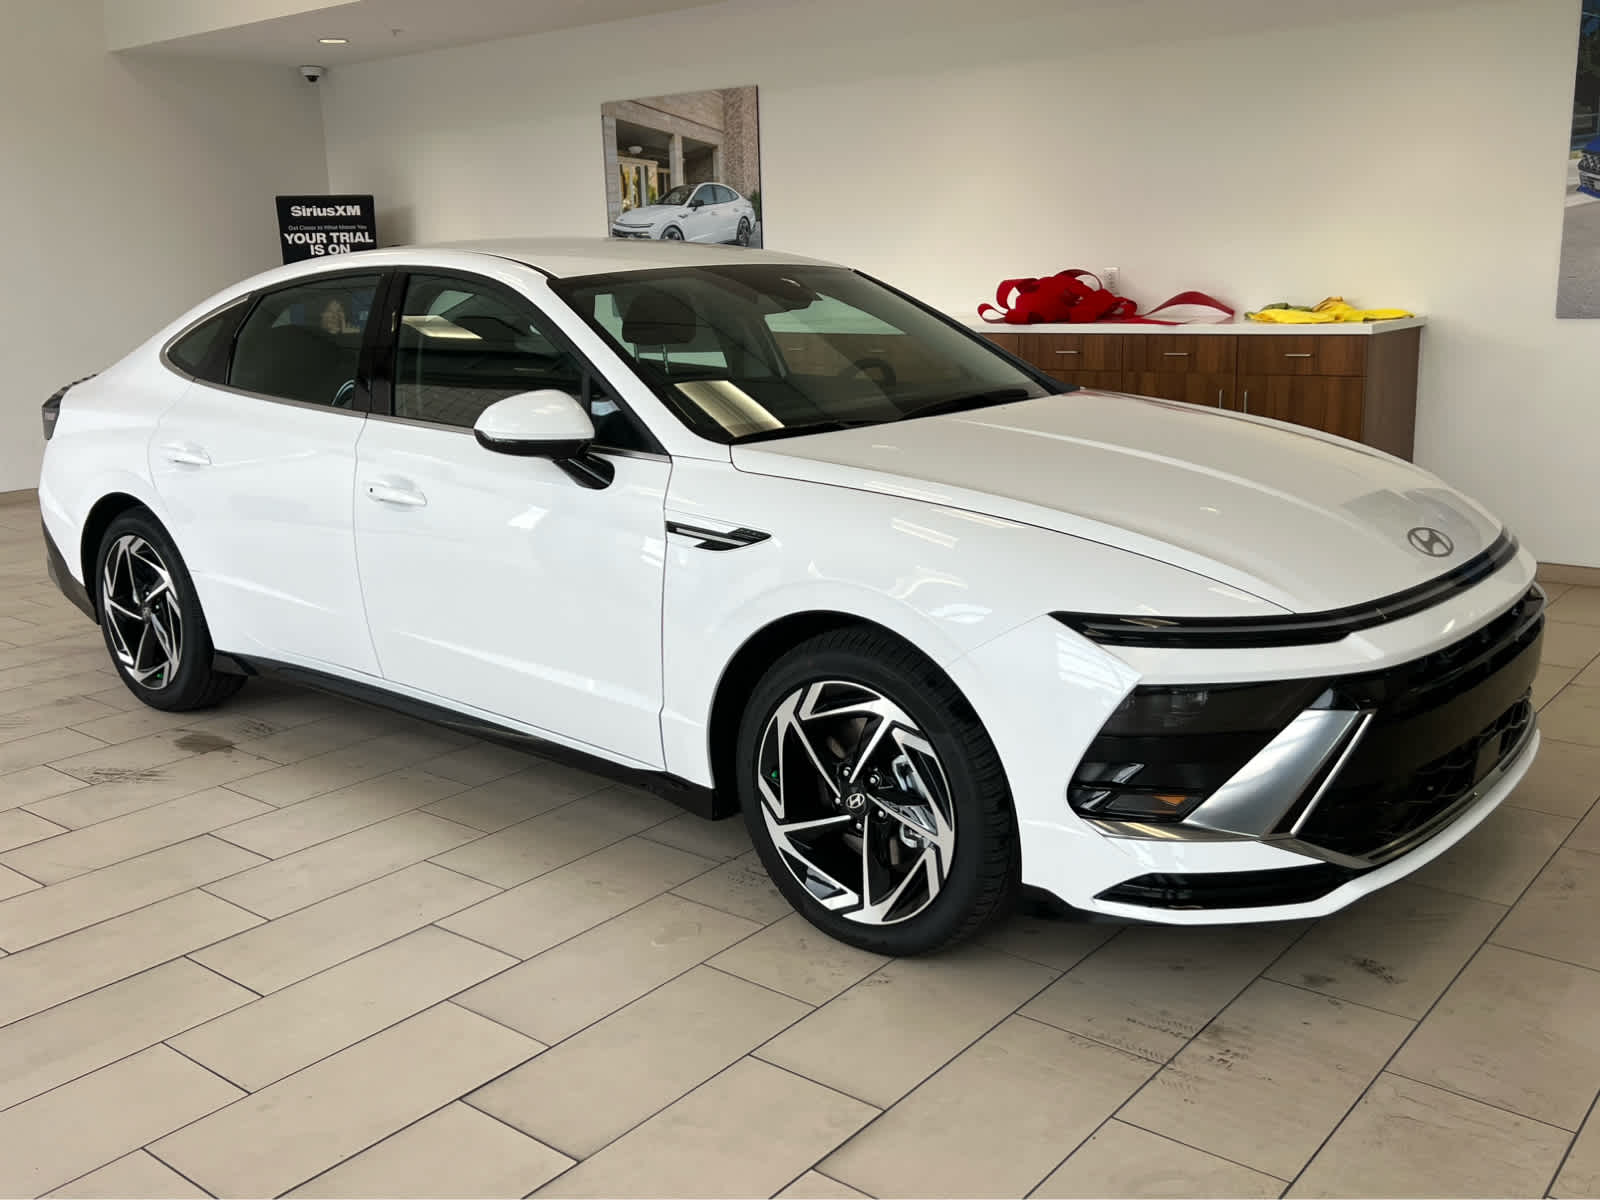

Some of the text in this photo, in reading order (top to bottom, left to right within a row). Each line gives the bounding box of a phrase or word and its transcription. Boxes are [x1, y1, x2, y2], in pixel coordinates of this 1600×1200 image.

[290, 205, 361, 217] SiriusXM
[283, 231, 374, 245] YOUR TRIAL
[310, 243, 351, 256] IS ON
